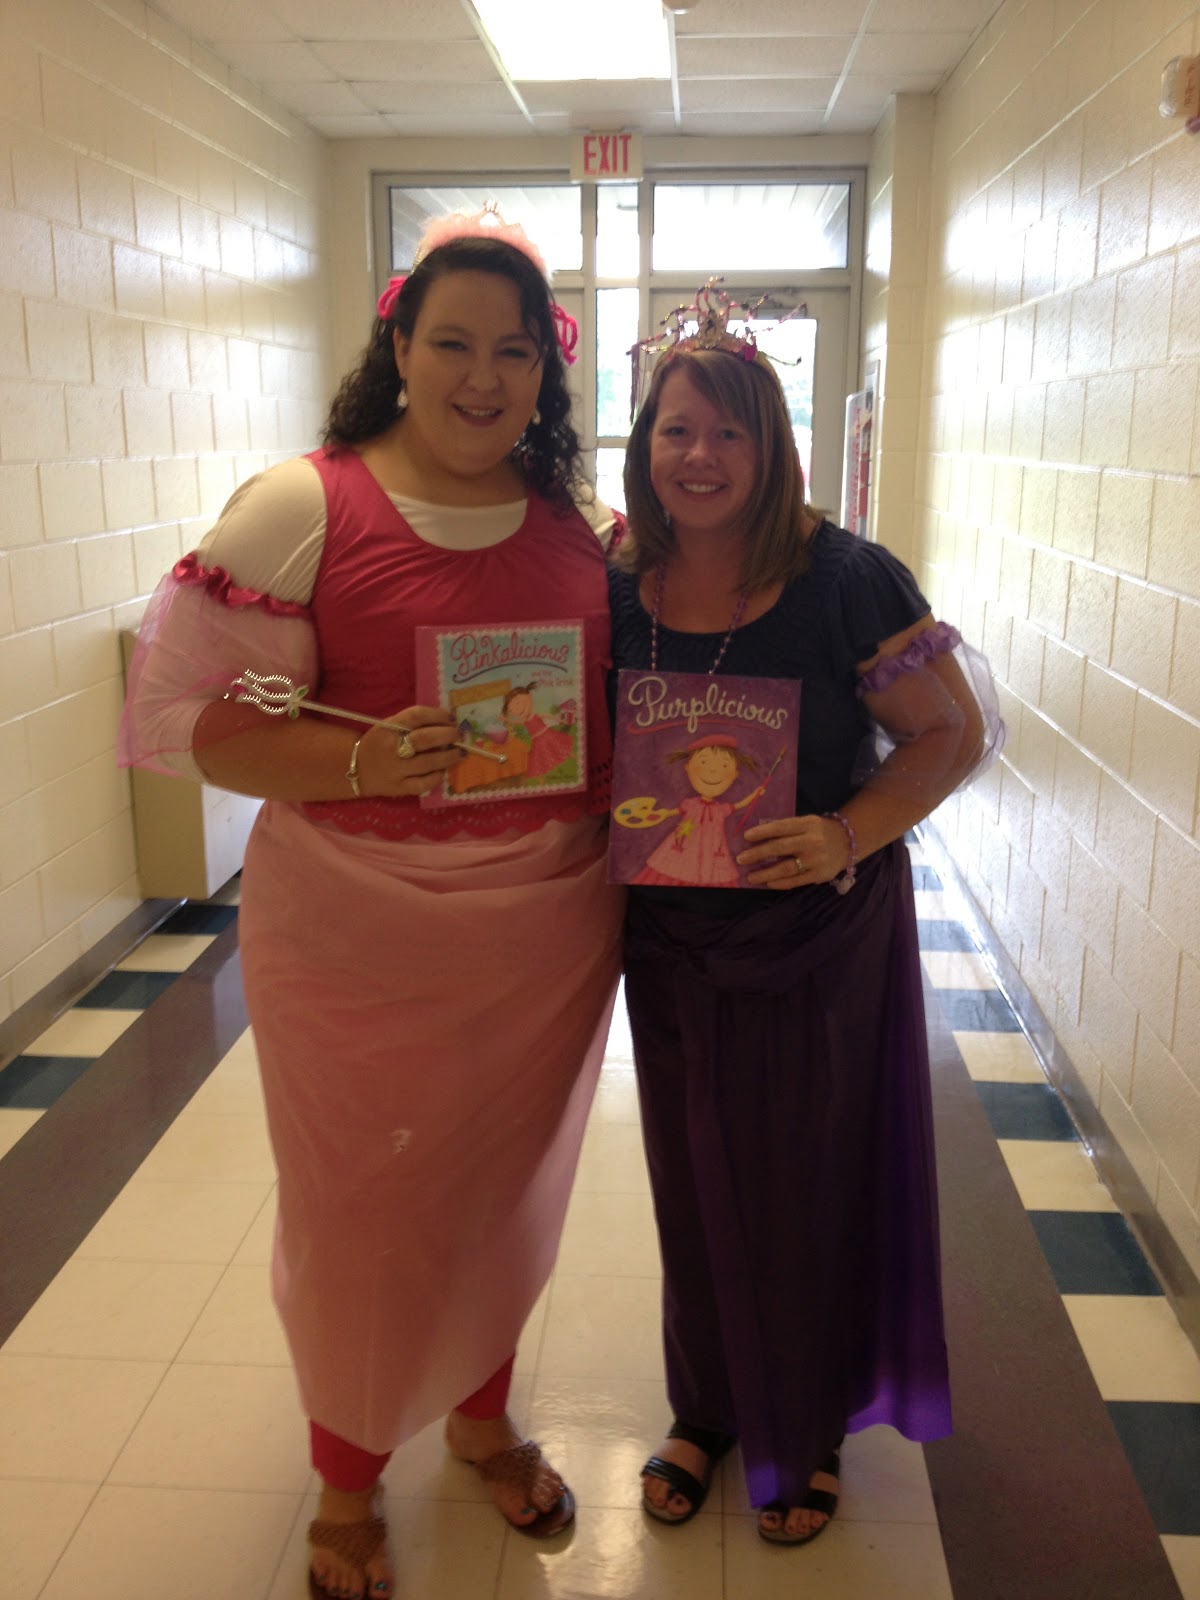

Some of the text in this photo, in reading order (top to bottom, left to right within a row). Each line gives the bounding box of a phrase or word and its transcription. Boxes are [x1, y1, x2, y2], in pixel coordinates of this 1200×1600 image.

[583, 134, 632, 175] EXIT
[450, 631, 570, 676] Pinkalicious
[627, 675, 789, 734] Purplicious
